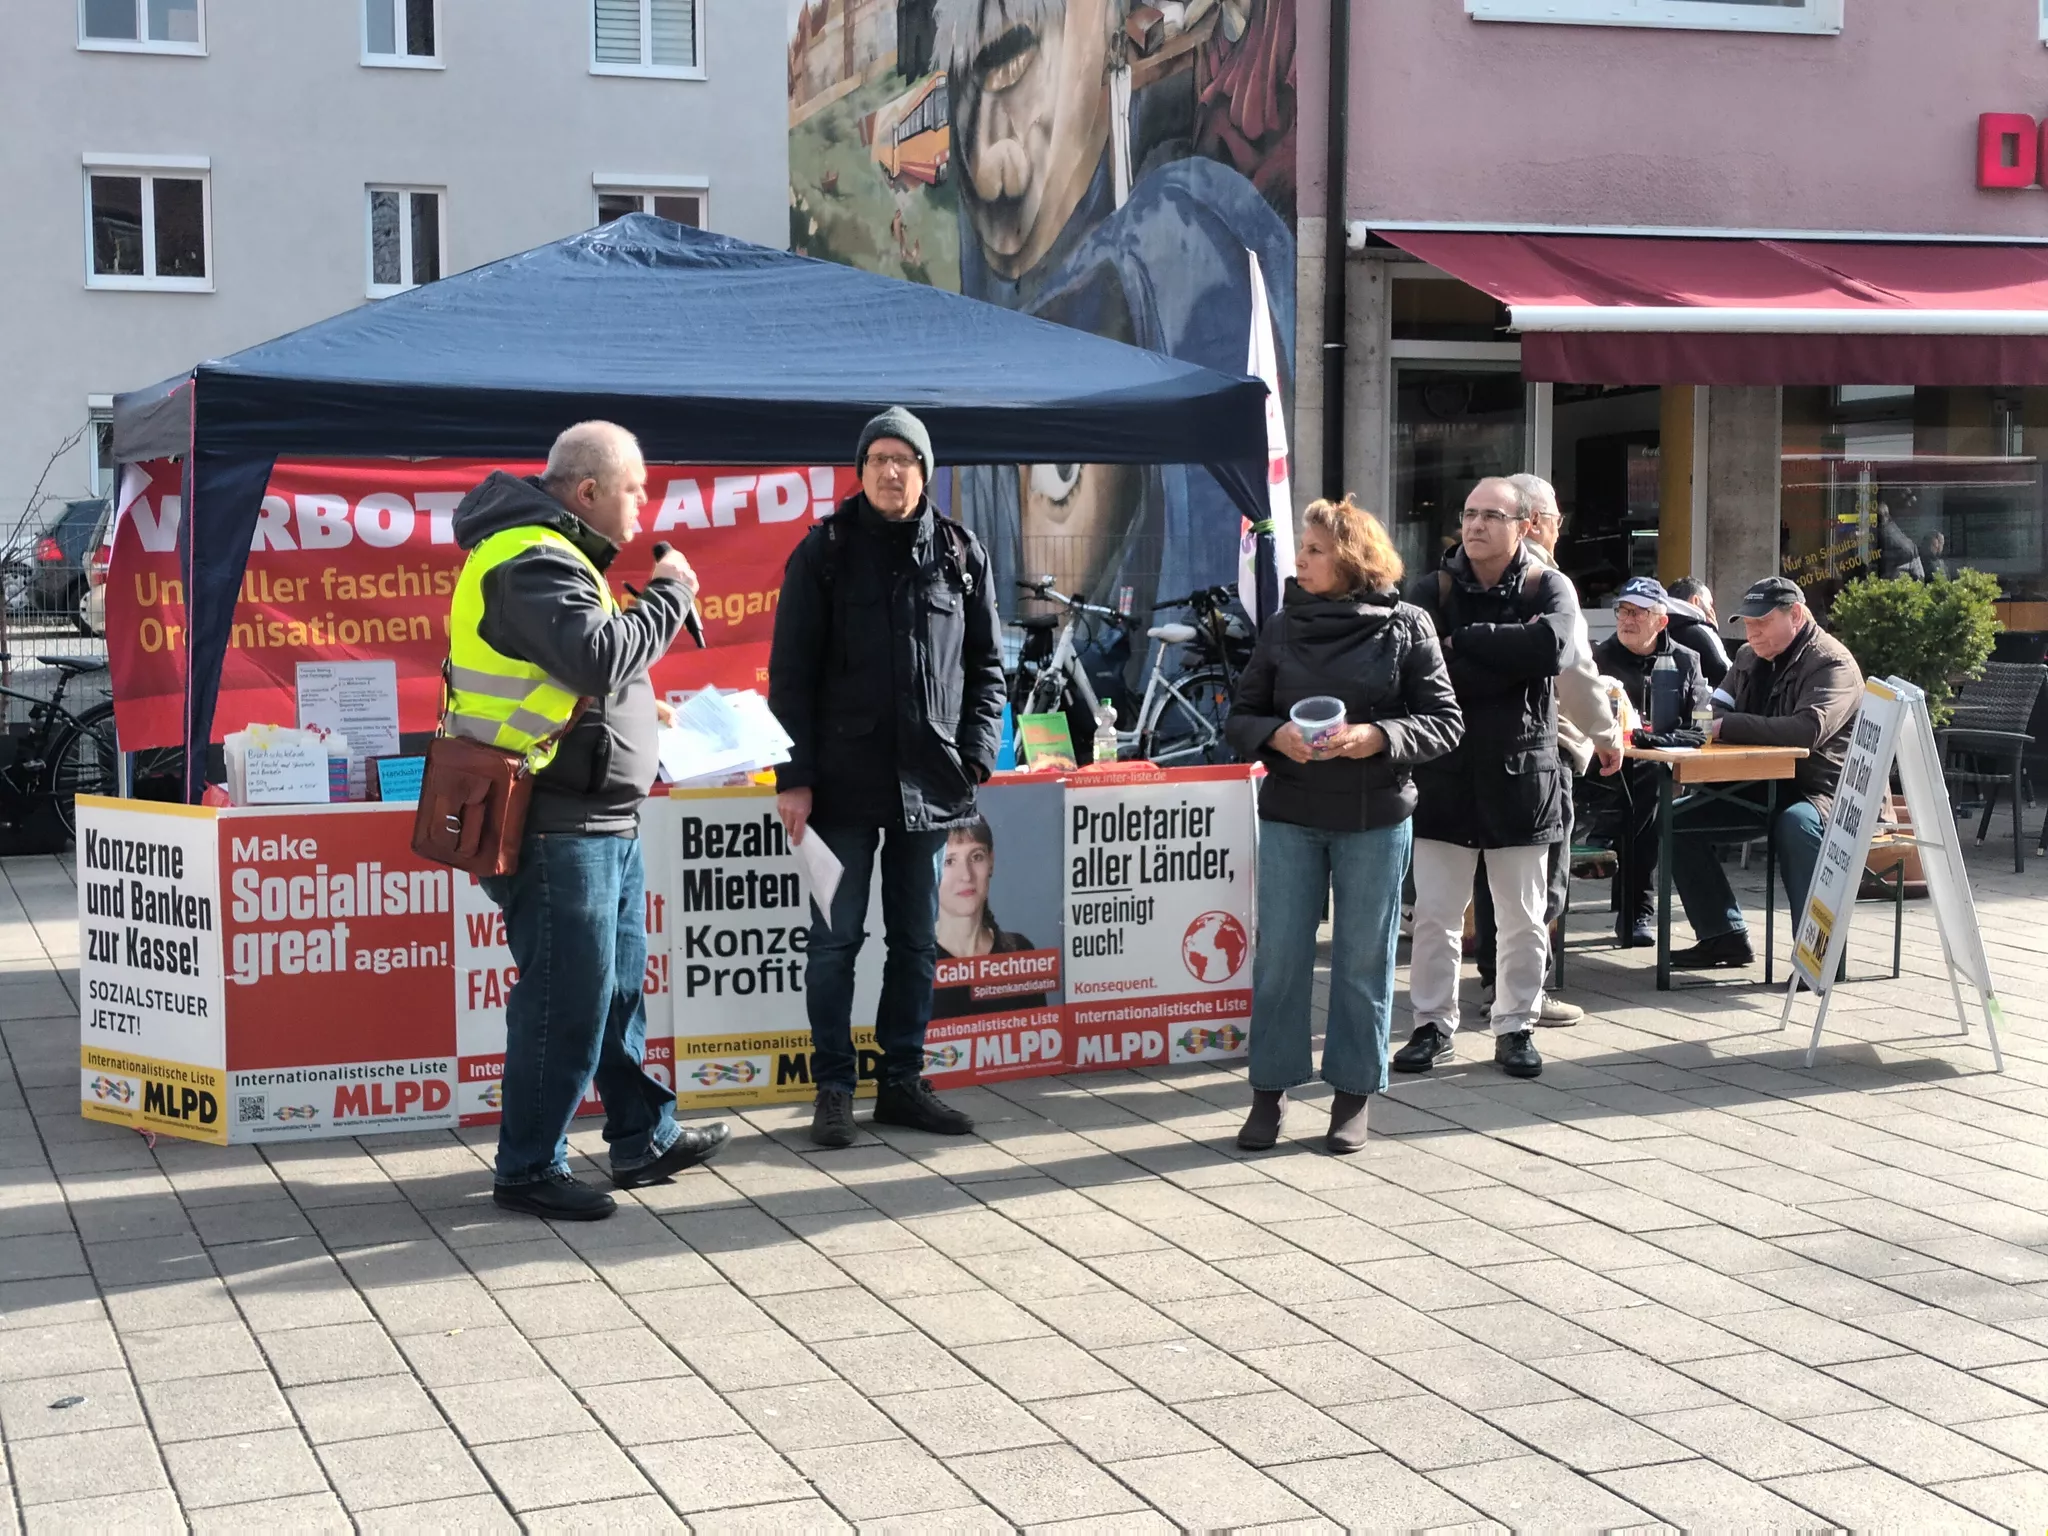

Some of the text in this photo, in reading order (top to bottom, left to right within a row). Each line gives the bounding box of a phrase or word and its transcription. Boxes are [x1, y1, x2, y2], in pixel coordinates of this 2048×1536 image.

[1977, 112, 2048, 192] D
[130, 466, 836, 552] VRBOT AFD!
[1804, 553, 1818, 566] an
[135, 564, 465, 607] Un ller faschist
[1796, 573, 1814, 588] :00
[139, 611, 432, 653] Ornisationen
[1074, 770, 1168, 785] www.inter-liste.de
[682, 813, 793, 860] Bezah
[1072, 800, 1215, 845] Proletarier
[85, 828, 184, 880] Konzerne
[231, 834, 318, 863] Make
[1072, 841, 1235, 889] aller Länder,
[86, 878, 212, 931] und Banken
[231, 861, 449, 923] Socialism
[683, 867, 800, 913] Mieten
[1071, 895, 1155, 926] vereinigt
[88, 926, 199, 977] zur Kasse!
[232, 922, 448, 985] great again!
[1072, 928, 1124, 958] euch!
[935, 956, 1056, 984] Gabi Fechtner
[1074, 977, 1158, 995] Konsequent.
[89, 980, 208, 1018] SOZIALSTEUER
[974, 979, 1056, 998] Spitzenkandidatin
[90, 1008, 141, 1036] JETZT!
[926, 1012, 1060, 1040] rnationalistische Liste
[1074, 998, 1248, 1025] Internationalistische Liste
[645, 1045, 671, 1060] iste
[686, 1034, 816, 1055] Internationalistis
[975, 1028, 1063, 1069] MLPD
[1076, 1030, 1165, 1065] MLPD
[88, 1052, 216, 1087] Internationalistische Liste
[235, 1063, 405, 1087] Internationalistische
[410, 1061, 449, 1076] Liste
[144, 1080, 218, 1124] MLPD
[333, 1079, 452, 1119] MLPD
